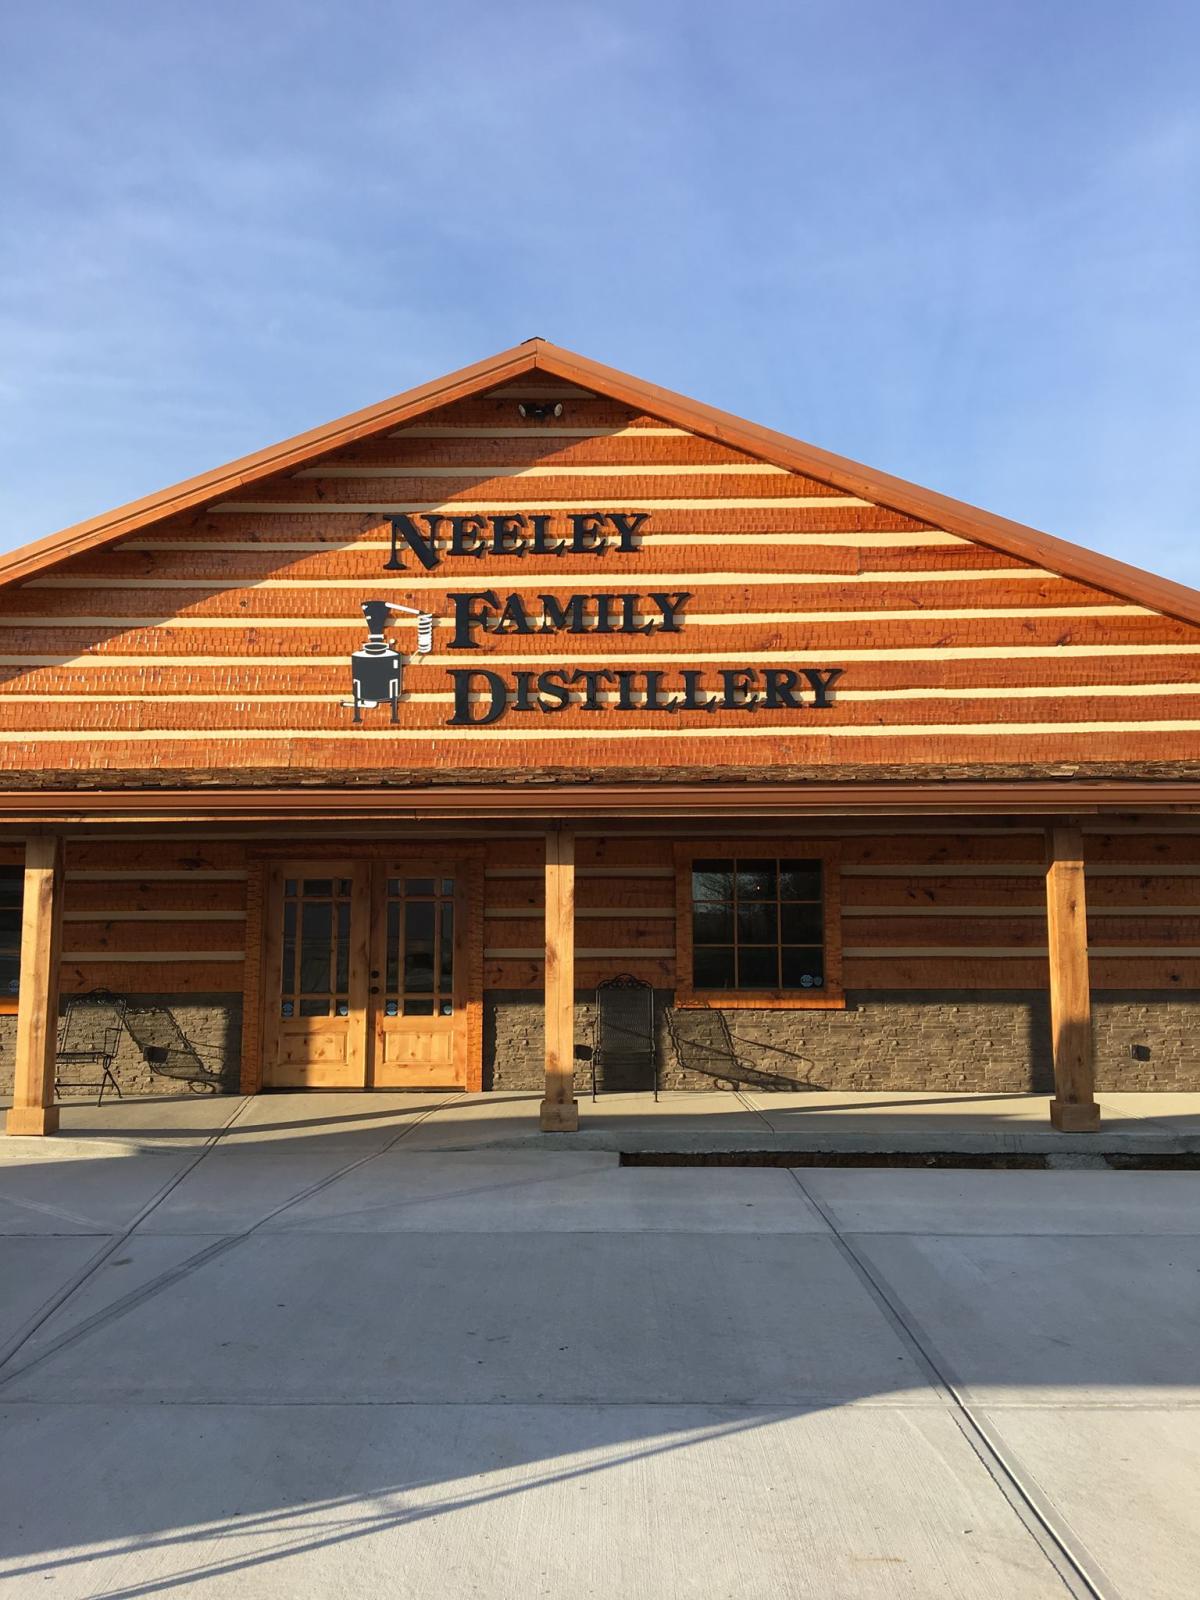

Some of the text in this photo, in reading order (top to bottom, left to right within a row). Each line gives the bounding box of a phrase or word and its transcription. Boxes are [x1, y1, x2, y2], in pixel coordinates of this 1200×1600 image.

[383, 512, 650, 571] NEELEY
[446, 589, 691, 649] FAMILY
[446, 667, 843, 726] DISTILLERY
